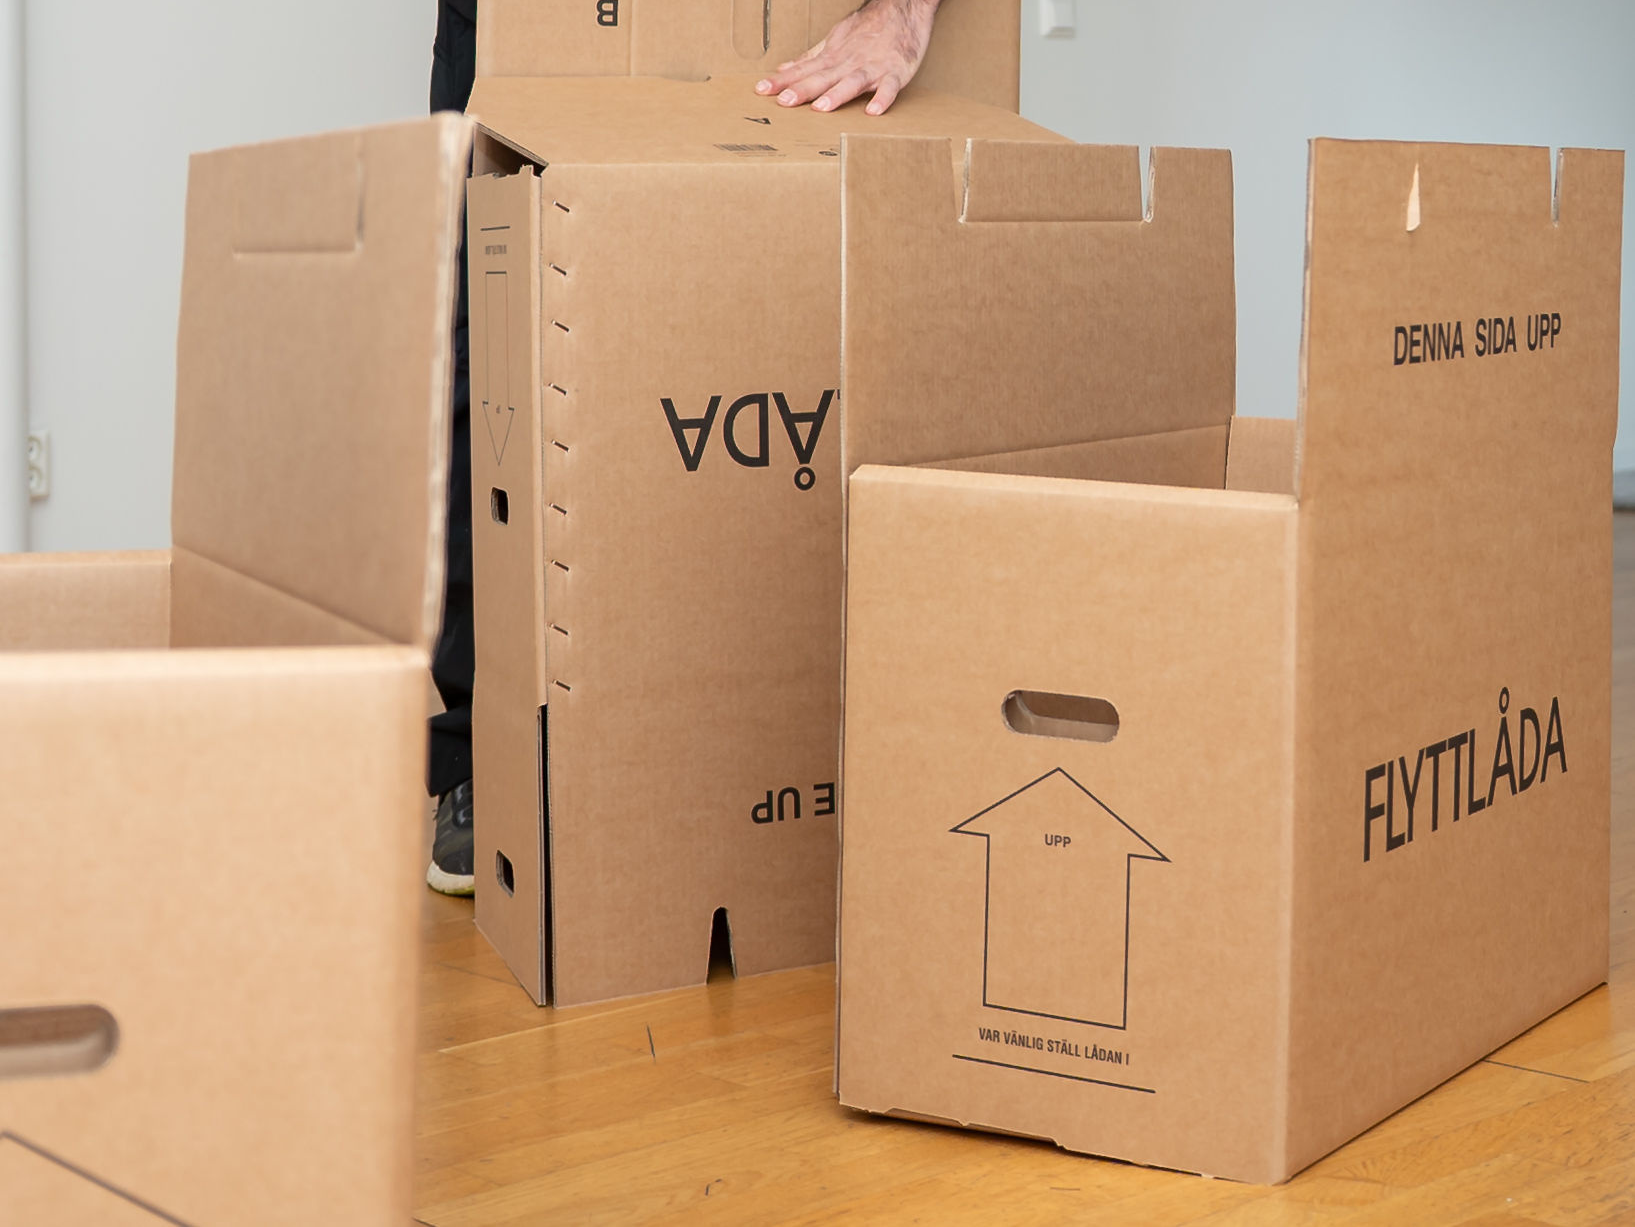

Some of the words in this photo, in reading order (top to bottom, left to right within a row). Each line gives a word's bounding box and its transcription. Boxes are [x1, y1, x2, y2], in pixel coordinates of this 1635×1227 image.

[1394, 322, 1464, 366] DENNA
[1476, 316, 1517, 357] SIDA
[1528, 313, 1562, 352] UPP
[660, 389, 840, 491] ÅDA
[1364, 687, 1568, 862] FLYTTLÅDA
[751, 787, 802, 824] UP
[1045, 834, 1072, 848] UPP
[979, 1028, 1000, 1043] VAR
[1003, 1030, 1043, 1051] VÄNLIG
[1047, 1039, 1081, 1057] STÄLL
[1084, 1044, 1122, 1064] LÅDAN
